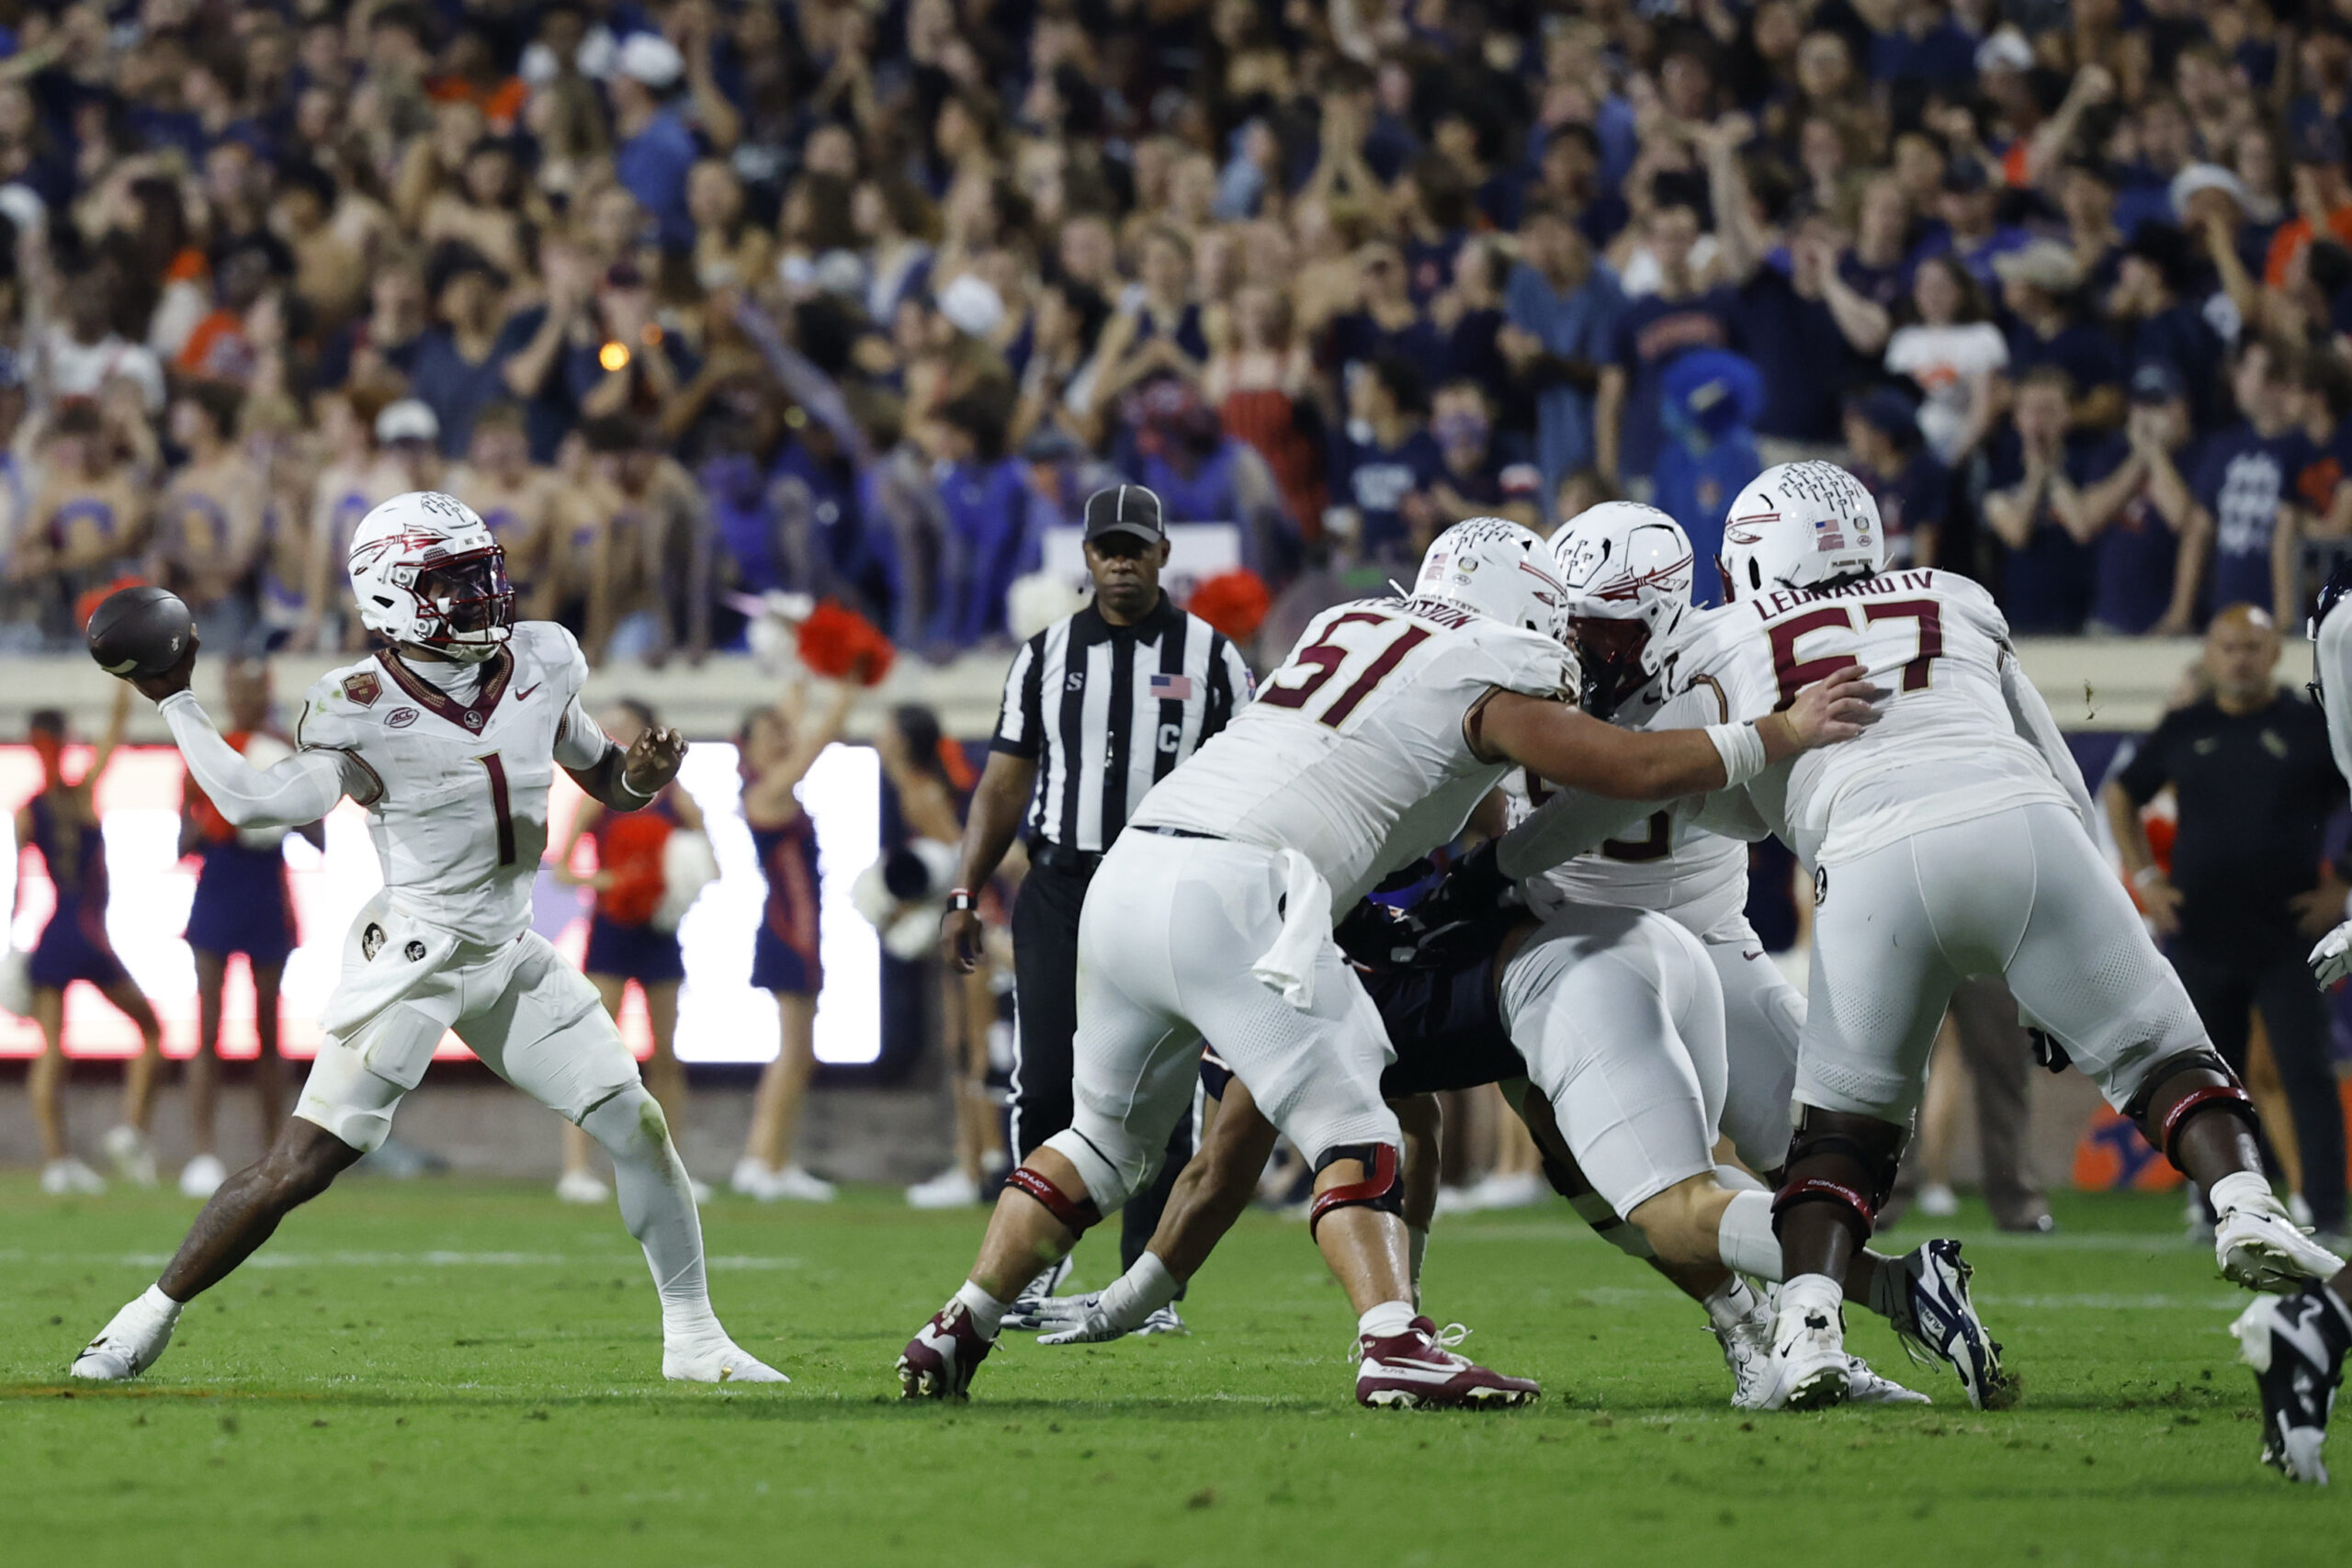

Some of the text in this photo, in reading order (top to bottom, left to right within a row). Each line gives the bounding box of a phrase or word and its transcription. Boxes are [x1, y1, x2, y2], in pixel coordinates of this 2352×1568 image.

[1902, 570, 1933, 590] IV
[1767, 599, 1944, 712] 67
[1066, 671, 1084, 692] S
[1257, 611, 1436, 731] 51
[389, 709, 414, 726] ACC
[1158, 723, 1182, 753] C
[470, 750, 516, 867] 1
